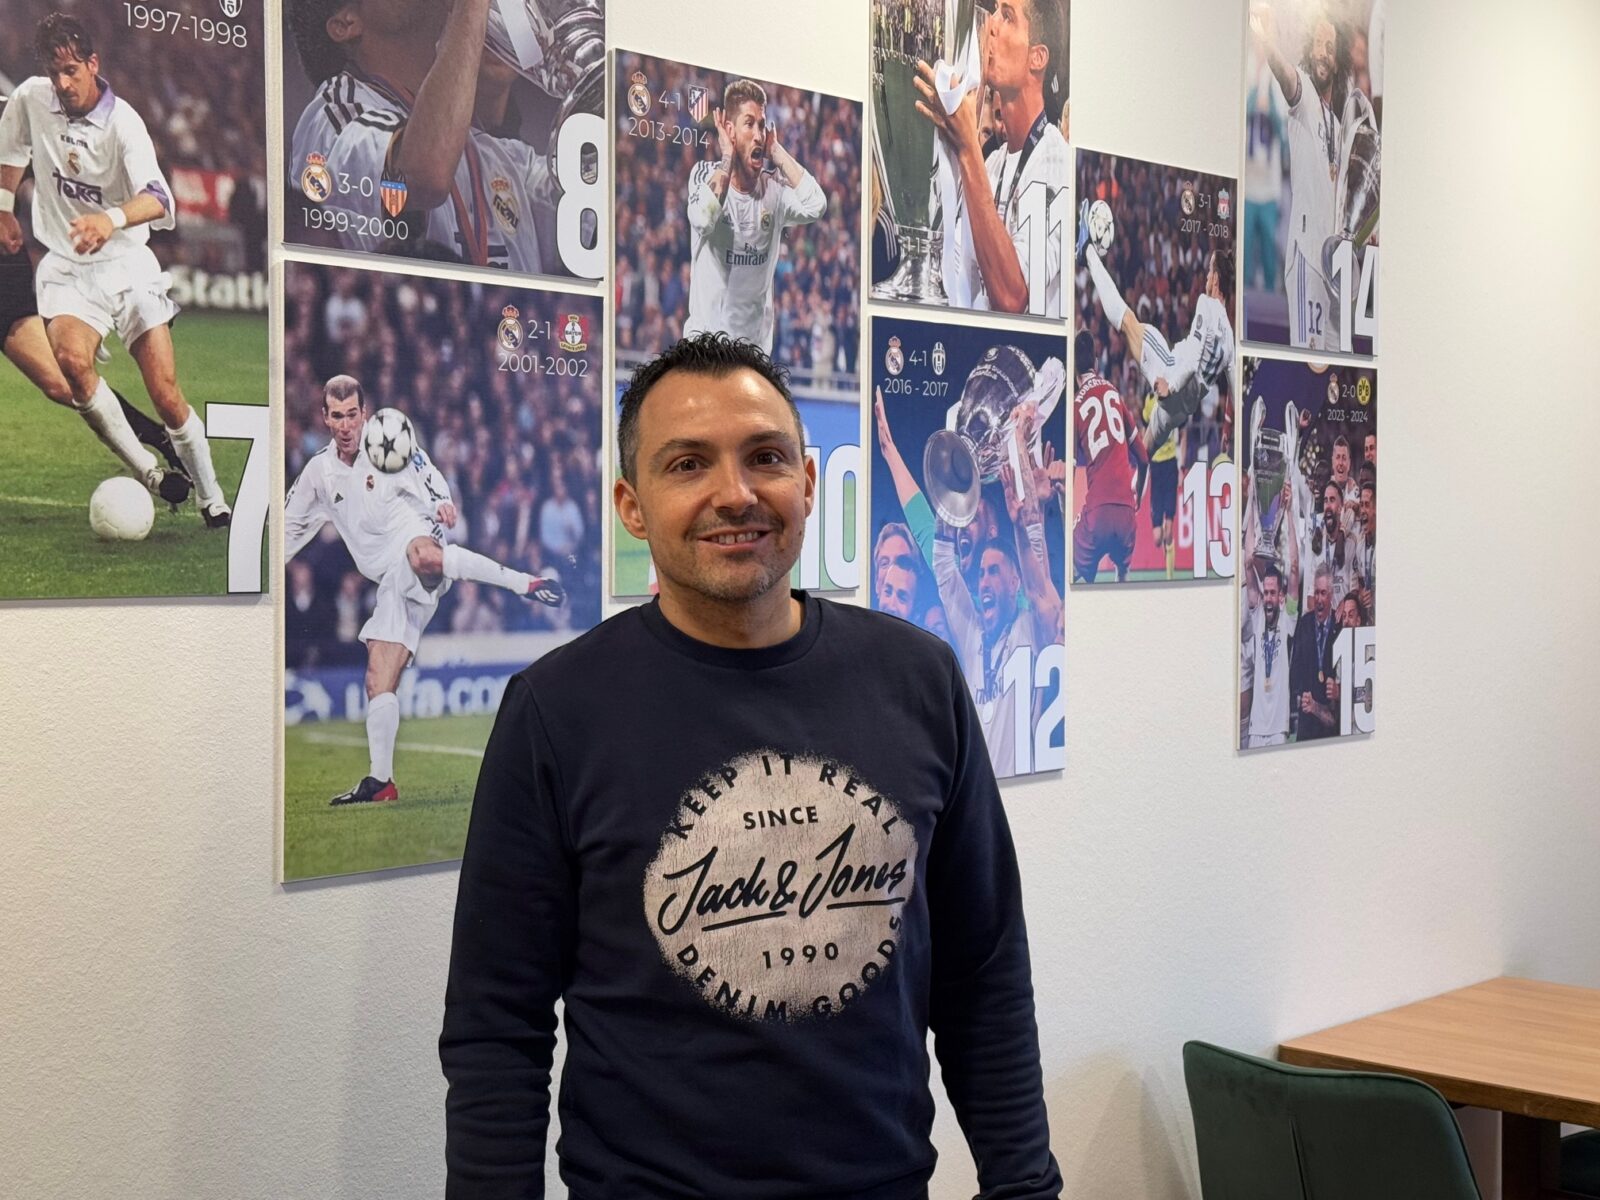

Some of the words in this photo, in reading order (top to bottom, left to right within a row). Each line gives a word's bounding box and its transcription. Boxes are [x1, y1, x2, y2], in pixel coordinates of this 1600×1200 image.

[124, 3, 247, 48] 1997-1998
[658, 92, 681, 111] 4-1
[628, 117, 710, 149] 2013-2014
[337, 172, 374, 197] 3-0
[556, 112, 605, 279] 8
[1198, 192, 1212, 208] 3-1
[302, 207, 409, 241] 1999-2000
[1181, 218, 1200, 233] 2017
[1208, 222, 1229, 239] 2018
[1017, 181, 1069, 320] 11
[1332, 239, 1379, 357] 14
[527, 320, 551, 340] 2-1
[1308, 300, 1322, 336] 12
[498, 353, 589, 378] 2001-2002
[909, 350, 927, 366] 4-1
[884, 377, 912, 395] 2016
[922, 381, 949, 397] 2017
[1342, 384, 1356, 398] 2-0
[1079, 389, 1125, 461] 26
[1327, 408, 1345, 421] 2023
[1350, 410, 1369, 423] 2024
[205, 401, 269, 593] 7
[799, 443, 861, 589] 10
[1183, 461, 1235, 578] 13
[1332, 626, 1376, 737] 15
[1003, 643, 1065, 776] 12
[665, 766, 738, 840] KEEP
[762, 754, 793, 777] IT
[819, 764, 899, 836] REAL
[743, 806, 819, 830] SINCE
[677, 943, 787, 1021] DENIM
[813, 915, 901, 1014] GOODS
[763, 942, 839, 969] 1990
